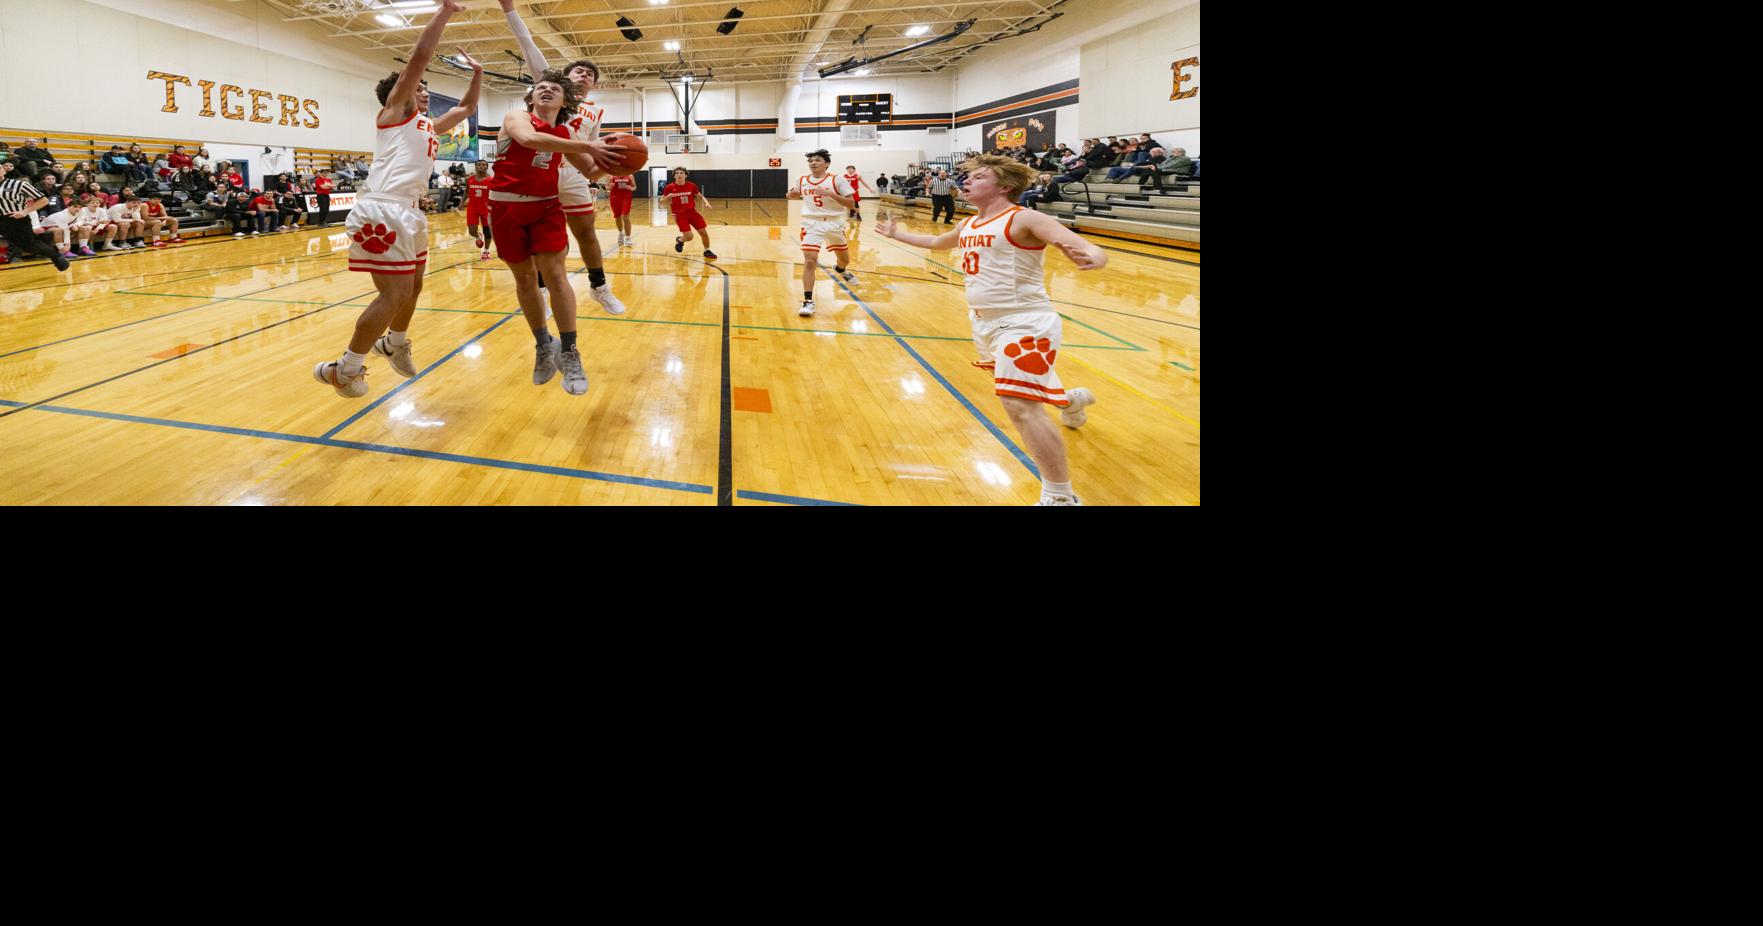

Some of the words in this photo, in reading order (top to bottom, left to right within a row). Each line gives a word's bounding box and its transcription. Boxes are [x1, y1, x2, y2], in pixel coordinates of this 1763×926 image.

[146, 69, 320, 129] TIGERS
[569, 117, 583, 133] 4
[531, 151, 554, 170] 2
[474, 189, 483, 198] 3
[813, 195, 824, 208] 5
[959, 234, 996, 248] NTIAT
